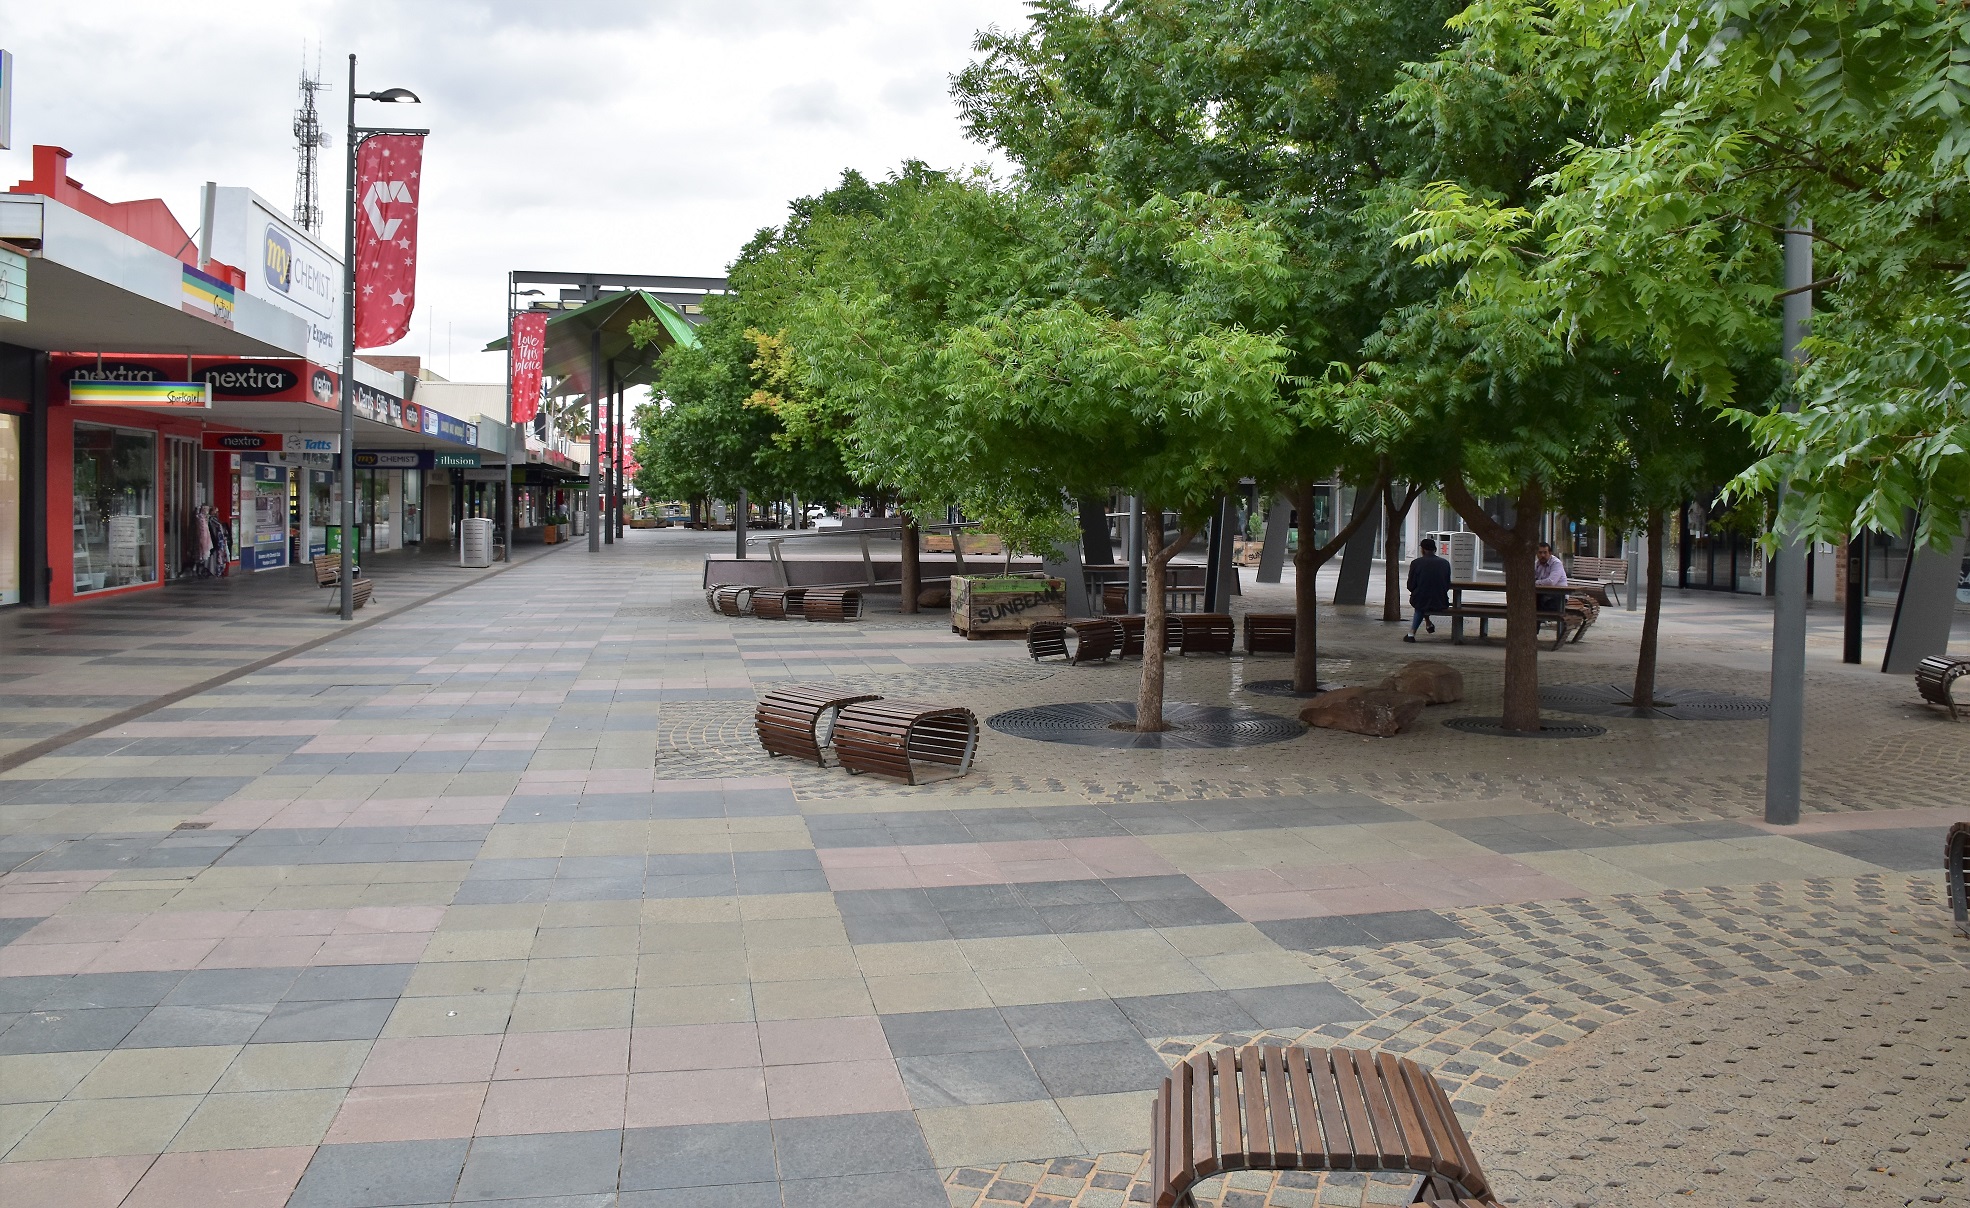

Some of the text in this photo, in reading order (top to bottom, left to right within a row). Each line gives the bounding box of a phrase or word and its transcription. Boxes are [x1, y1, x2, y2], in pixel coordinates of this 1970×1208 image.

[267, 238, 331, 300] my CHEMIST
[312, 323, 333, 349] Experts
[514, 358, 541, 377] place
[206, 367, 283, 389] nextra
[313, 375, 332, 395] nextra
[166, 390, 200, 405] Sportsgirl
[224, 436, 260, 446] nextra
[304, 439, 331, 450] Tatts
[357, 455, 416, 464] my CHEMIST
[441, 456, 474, 465] illusion
[977, 585, 1061, 624] SUNBEAM
